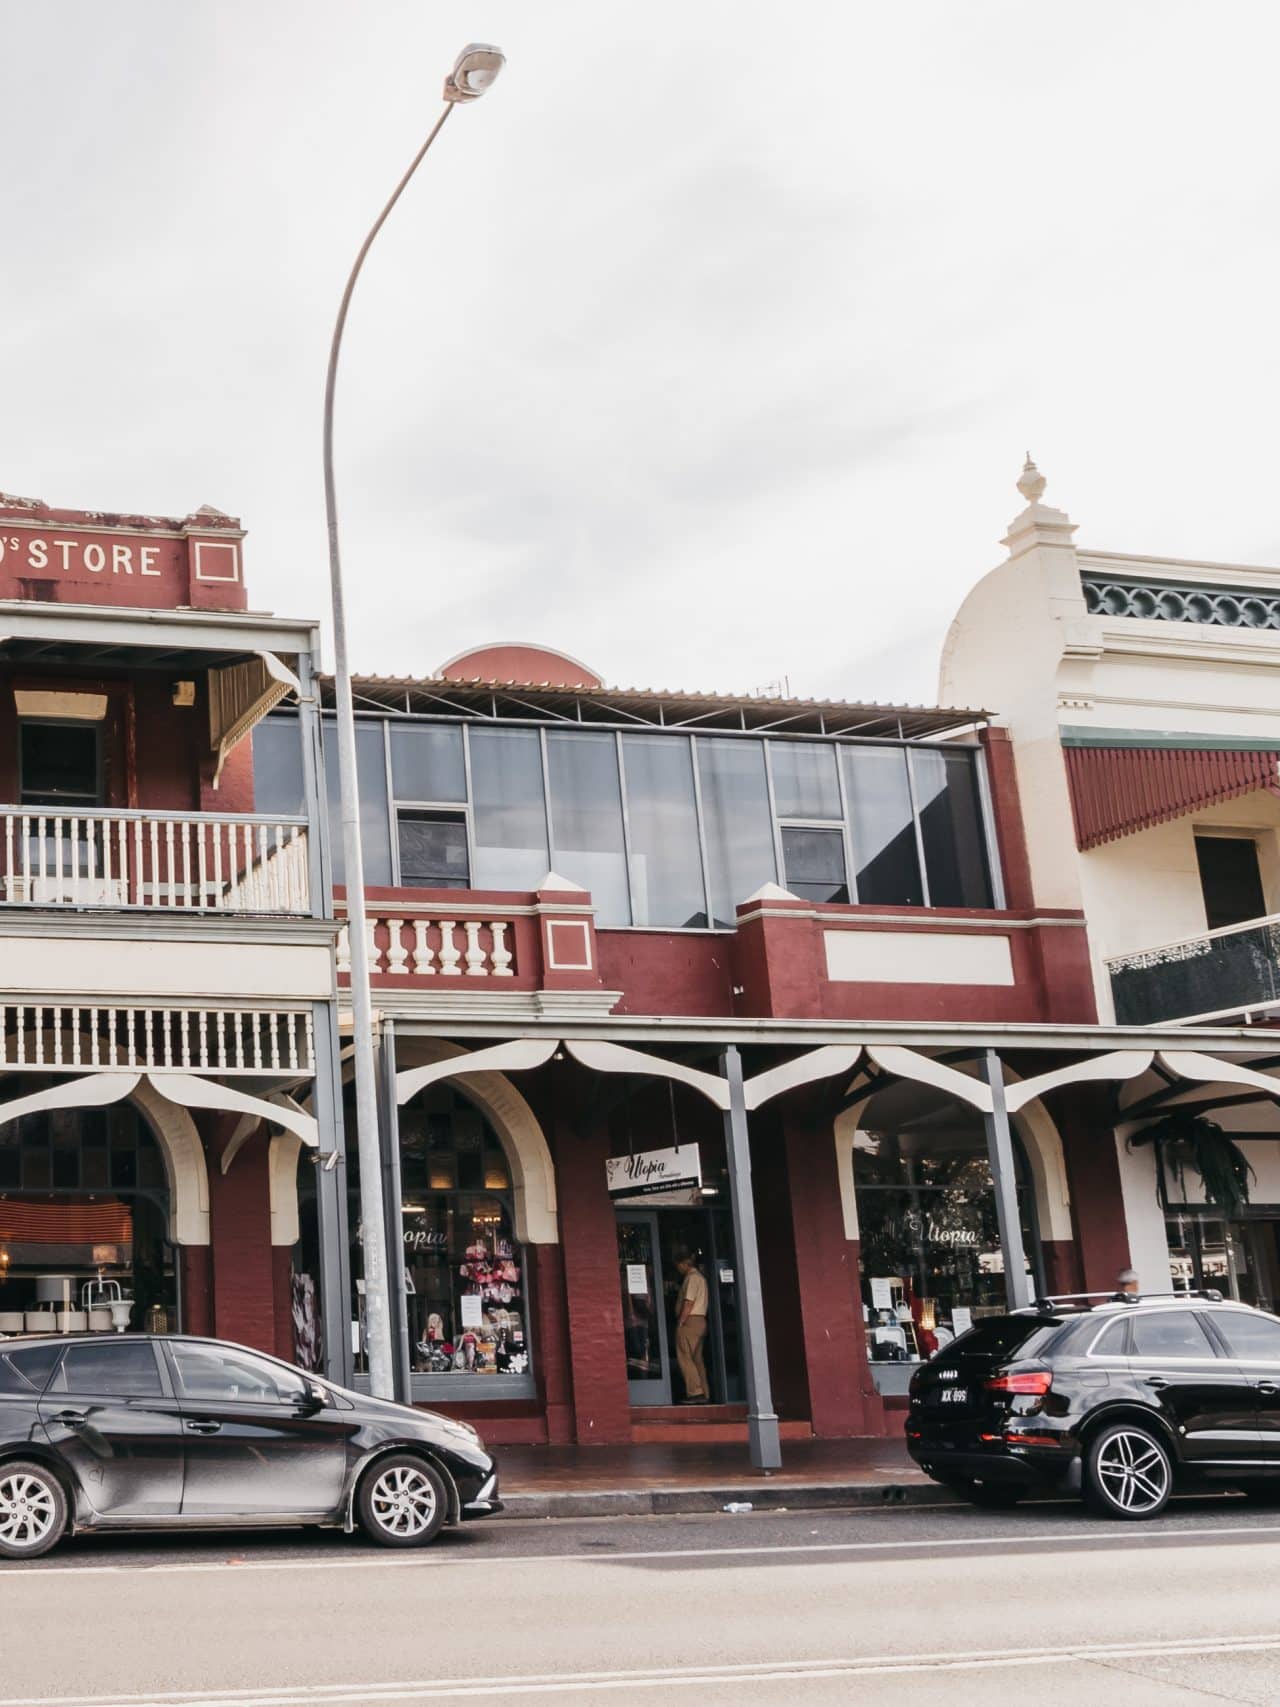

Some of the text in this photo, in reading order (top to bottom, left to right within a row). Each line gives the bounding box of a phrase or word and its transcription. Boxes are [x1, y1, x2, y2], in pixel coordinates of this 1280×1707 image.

[27, 539, 162, 577] STORE
[624, 1155, 666, 1182] Utopia
[403, 1228, 448, 1251] opia
[909, 1218, 978, 1249] Utopia
